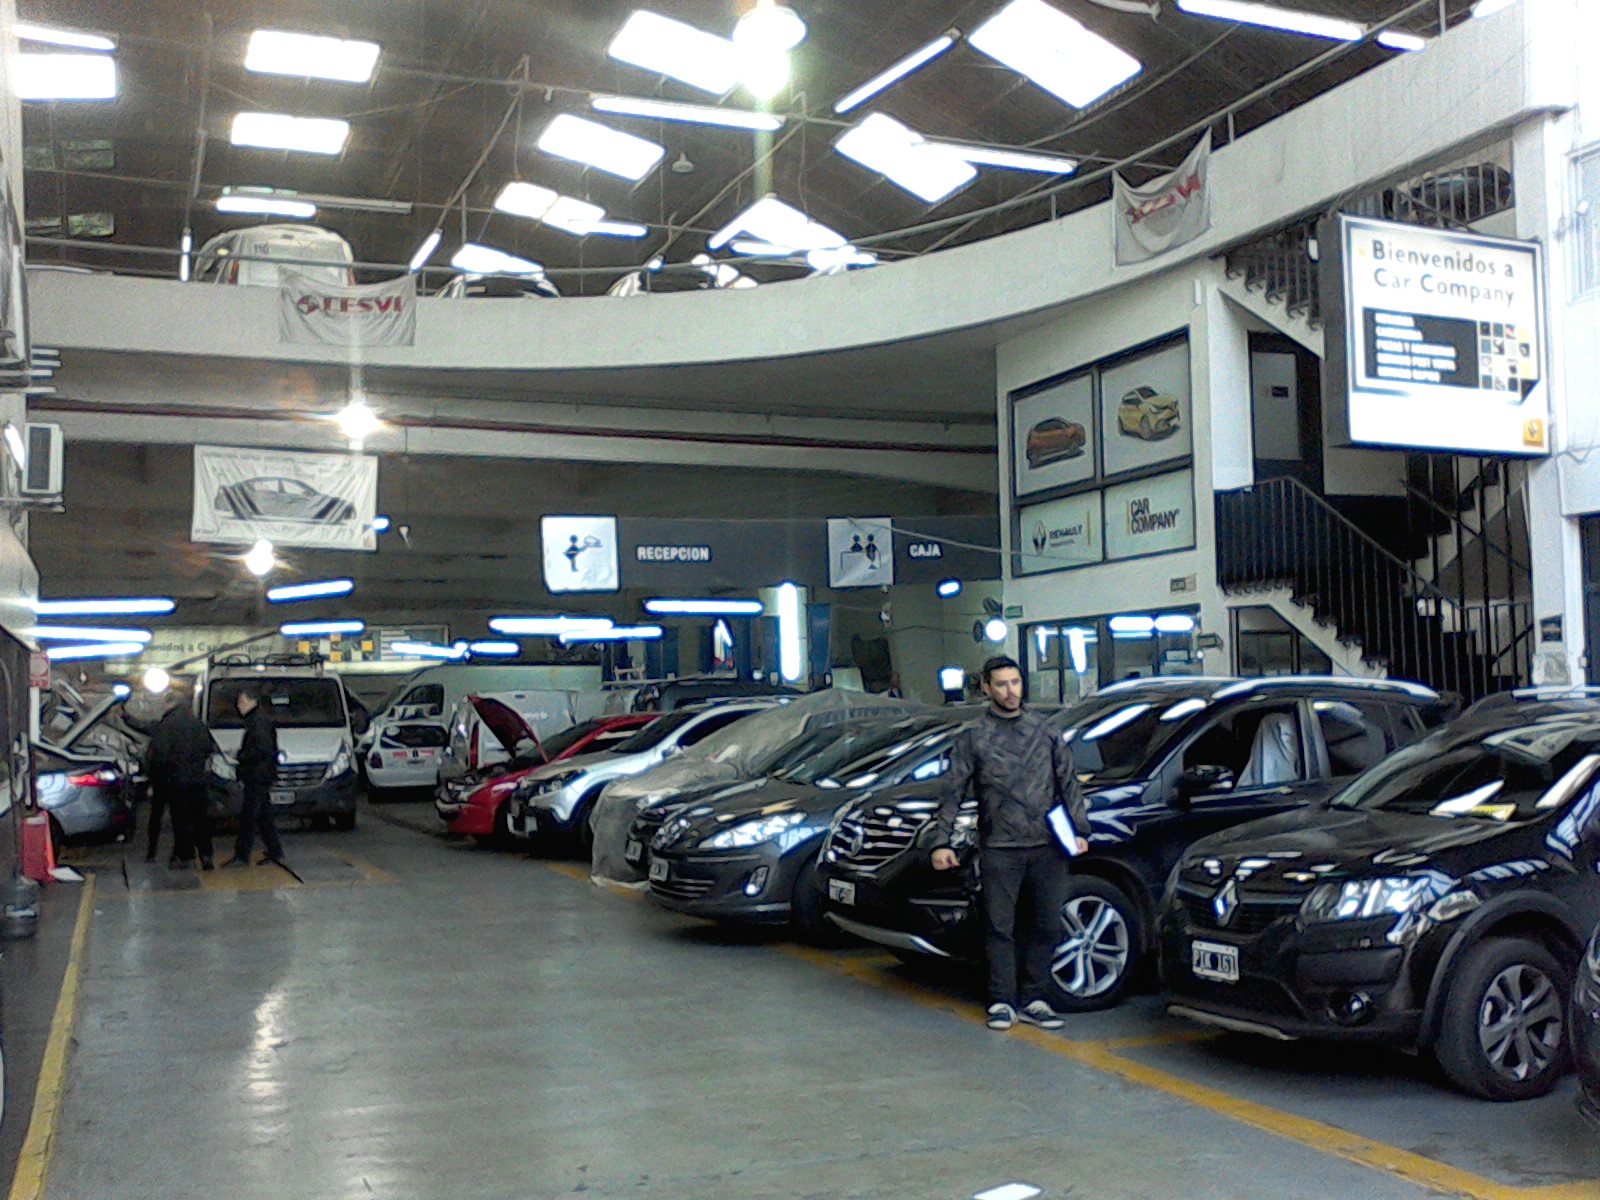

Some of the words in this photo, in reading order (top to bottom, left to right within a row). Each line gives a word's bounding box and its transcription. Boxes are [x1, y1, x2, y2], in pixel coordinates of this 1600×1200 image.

[1372, 239, 1496, 275] Bienvenidos
[1503, 263, 1514, 278] a
[1373, 267, 1412, 288] Car
[1420, 273, 1514, 308] Company
[1130, 498, 1150, 516] CAR
[1130, 508, 1179, 535] COMPANY
[637, 546, 710, 561] RECEPCION
[909, 543, 942, 557] CAJA
